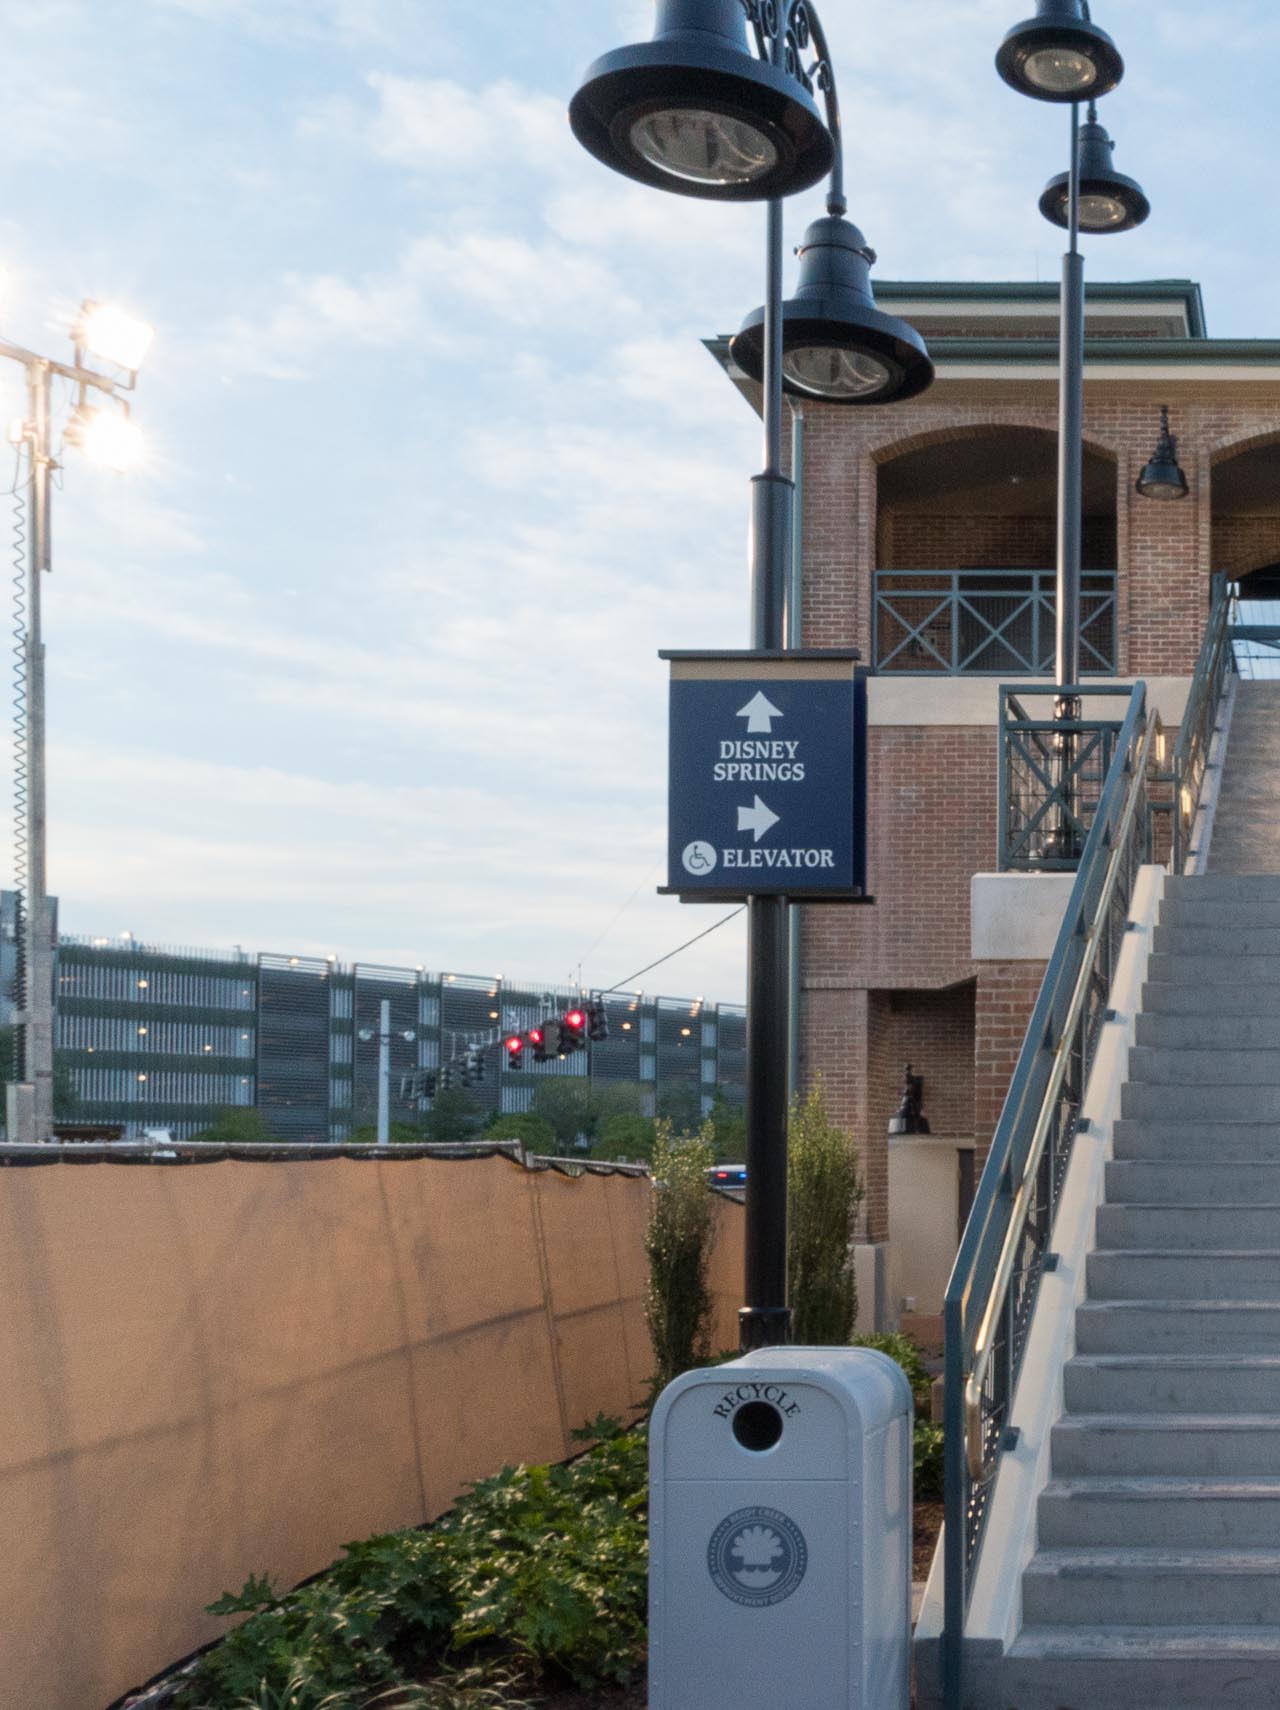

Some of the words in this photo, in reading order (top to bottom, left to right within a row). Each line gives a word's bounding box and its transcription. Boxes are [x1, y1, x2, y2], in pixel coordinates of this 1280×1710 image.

[720, 741, 799, 759] DISNEY
[713, 763, 805, 781] SPRINGS
[722, 849, 835, 868] ELEVATOR
[713, 1383, 801, 1419] RECYCLE
